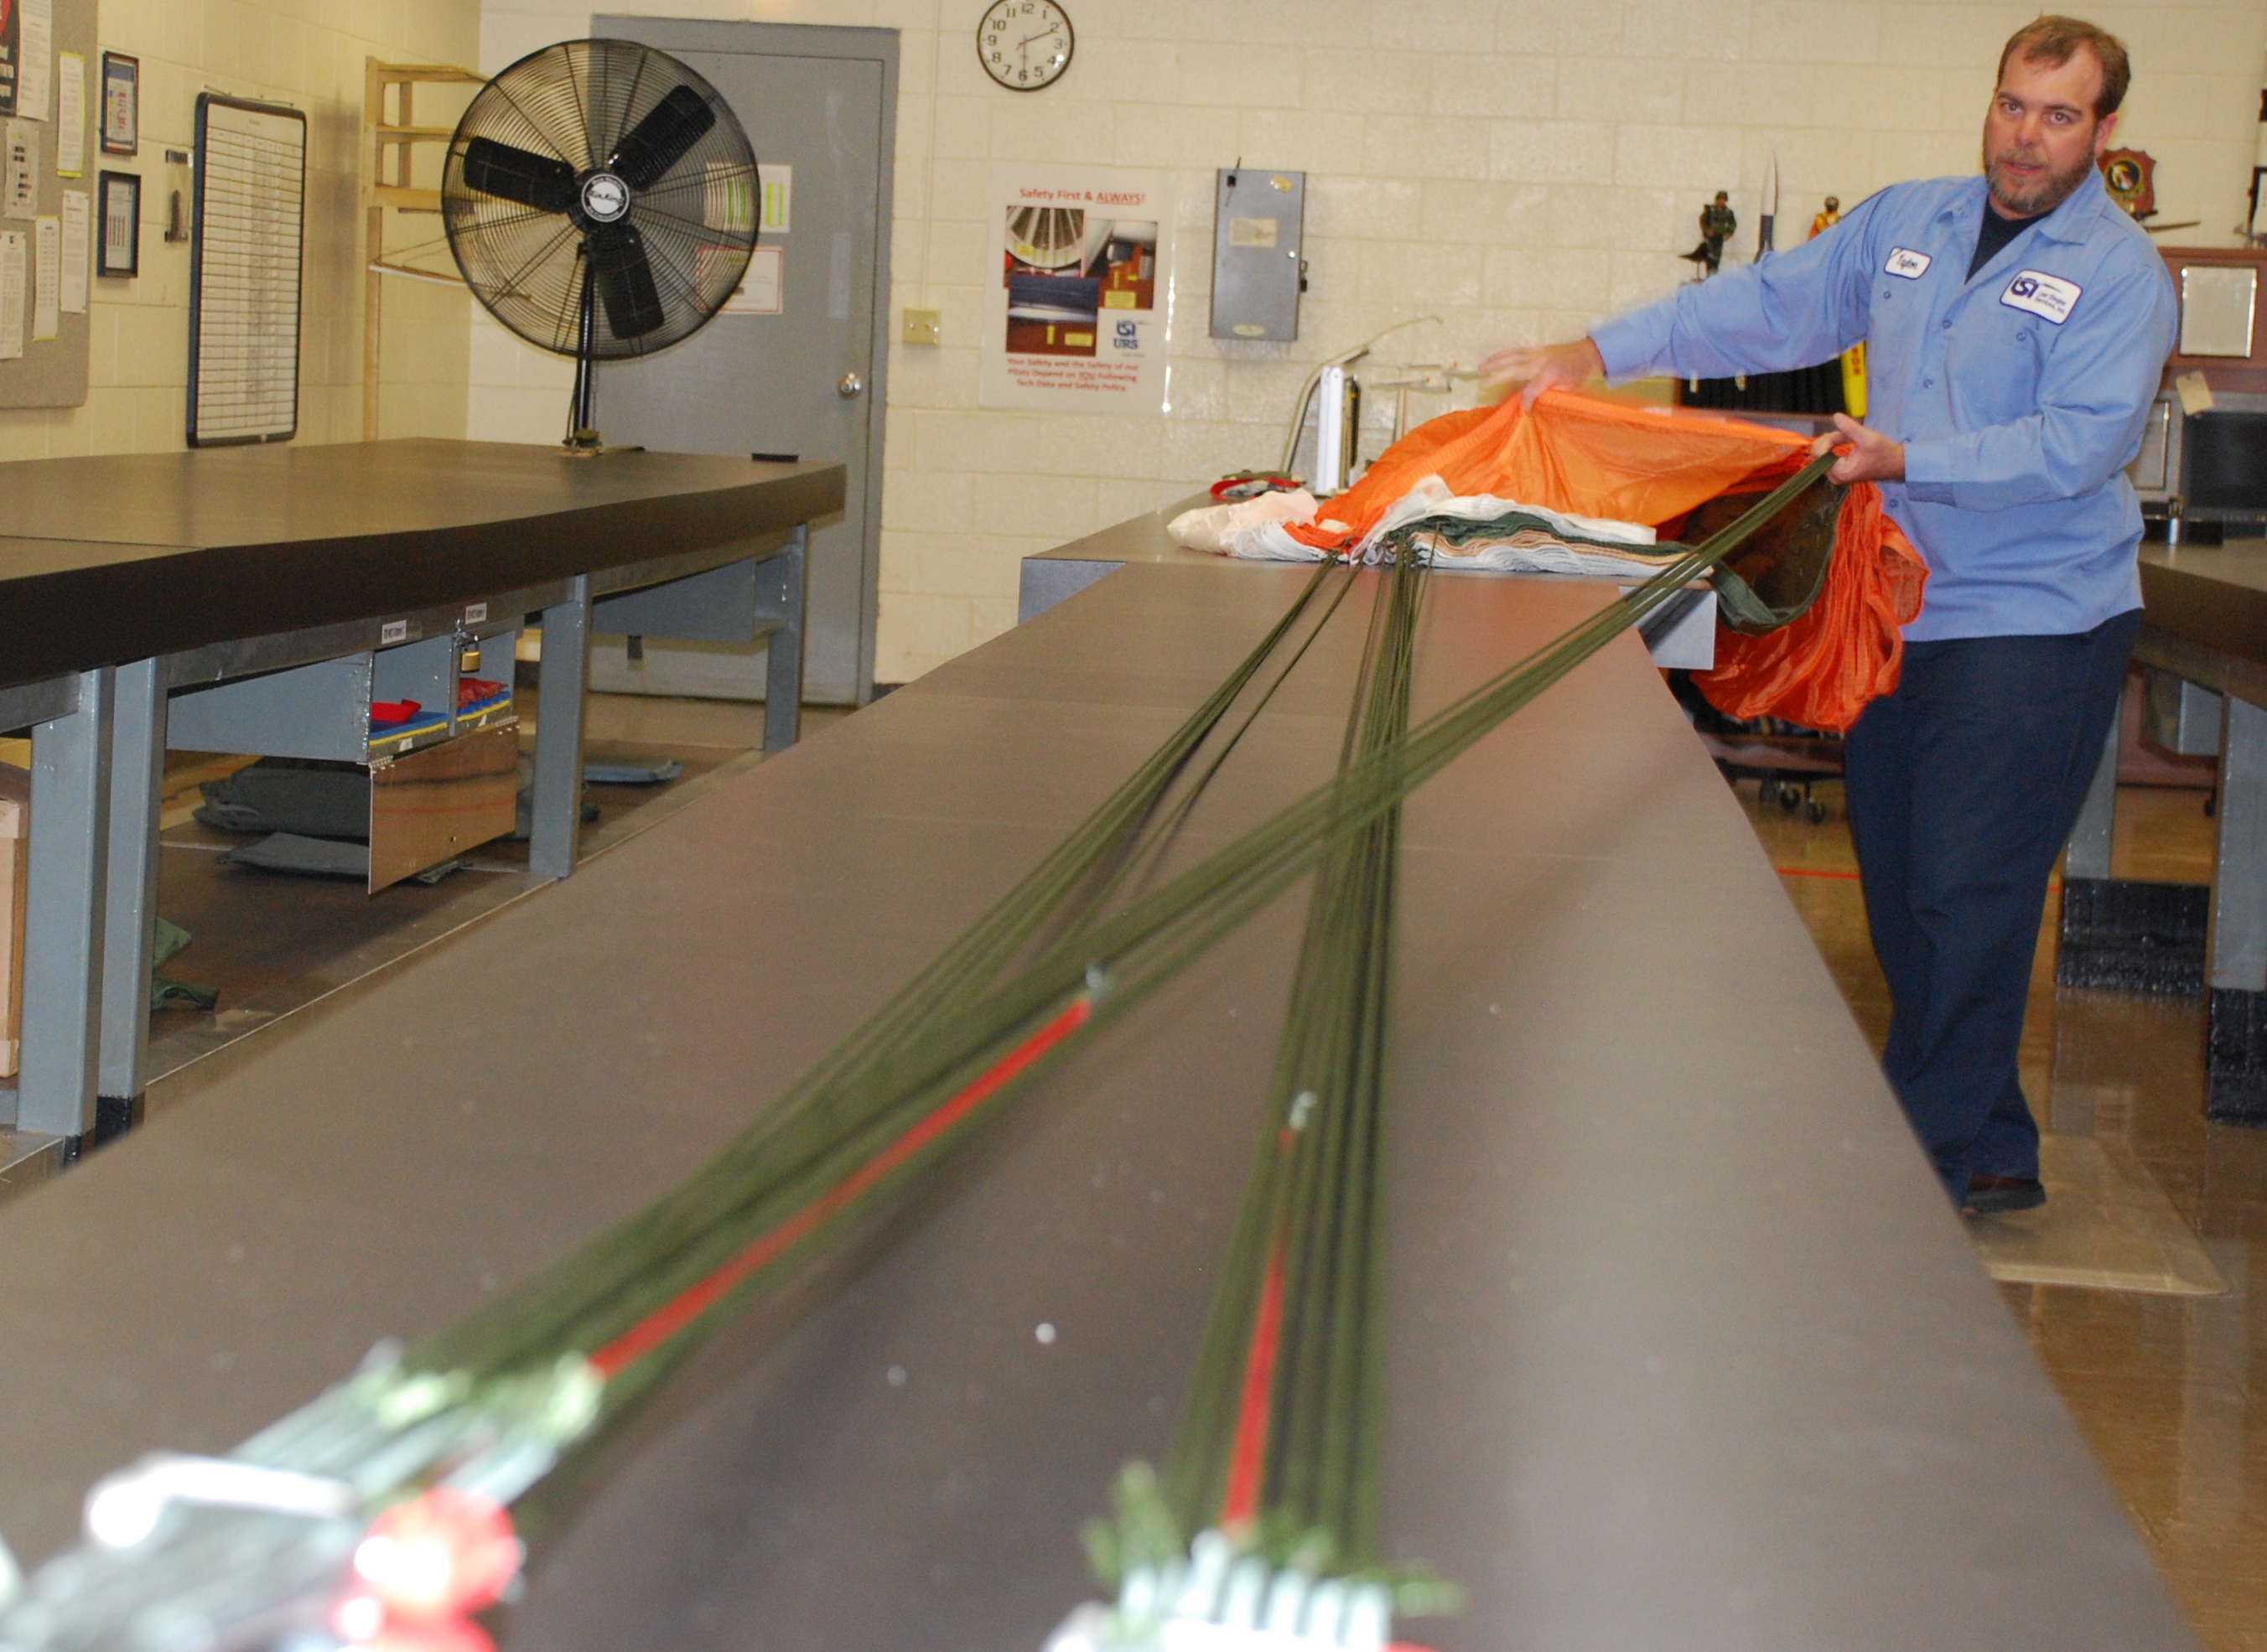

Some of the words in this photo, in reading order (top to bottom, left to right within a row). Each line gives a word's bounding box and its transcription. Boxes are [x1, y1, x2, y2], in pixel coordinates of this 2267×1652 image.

[1006, 8, 1015, 18] 11
[1021, 3, 1034, 14] 12
[993, 19, 1006, 31] 10
[1050, 22, 1059, 34] 2
[988, 34, 997, 46] 9
[1053, 38, 1063, 50] 3
[992, 51, 1001, 64] 8
[1046, 54, 1056, 65] 4
[1004, 65, 1012, 75] 7
[1018, 70, 1028, 81] 6
[1034, 66, 1044, 78] 5
[1019, 188, 1054, 201] Safety
[1057, 189, 1081, 201] First
[1085, 191, 1093, 201] &
[1097, 192, 1145, 204] ALWAYS!
[1113, 338, 1139, 350] URS
[1027, 358, 1051, 367] Safety
[1055, 359, 1069, 367] and
[1087, 360, 1112, 370] Safety
[1115, 362, 1123, 370] of
[1008, 367, 1030, 376] Pilots
[1032, 369, 1063, 379] Depend
[1079, 371, 1096, 381] YOU
[1098, 372, 1138, 383] Following
[1017, 379, 1034, 387] Tech
[1036, 380, 1055, 388] Data
[1076, 381, 1099, 391] Safety
